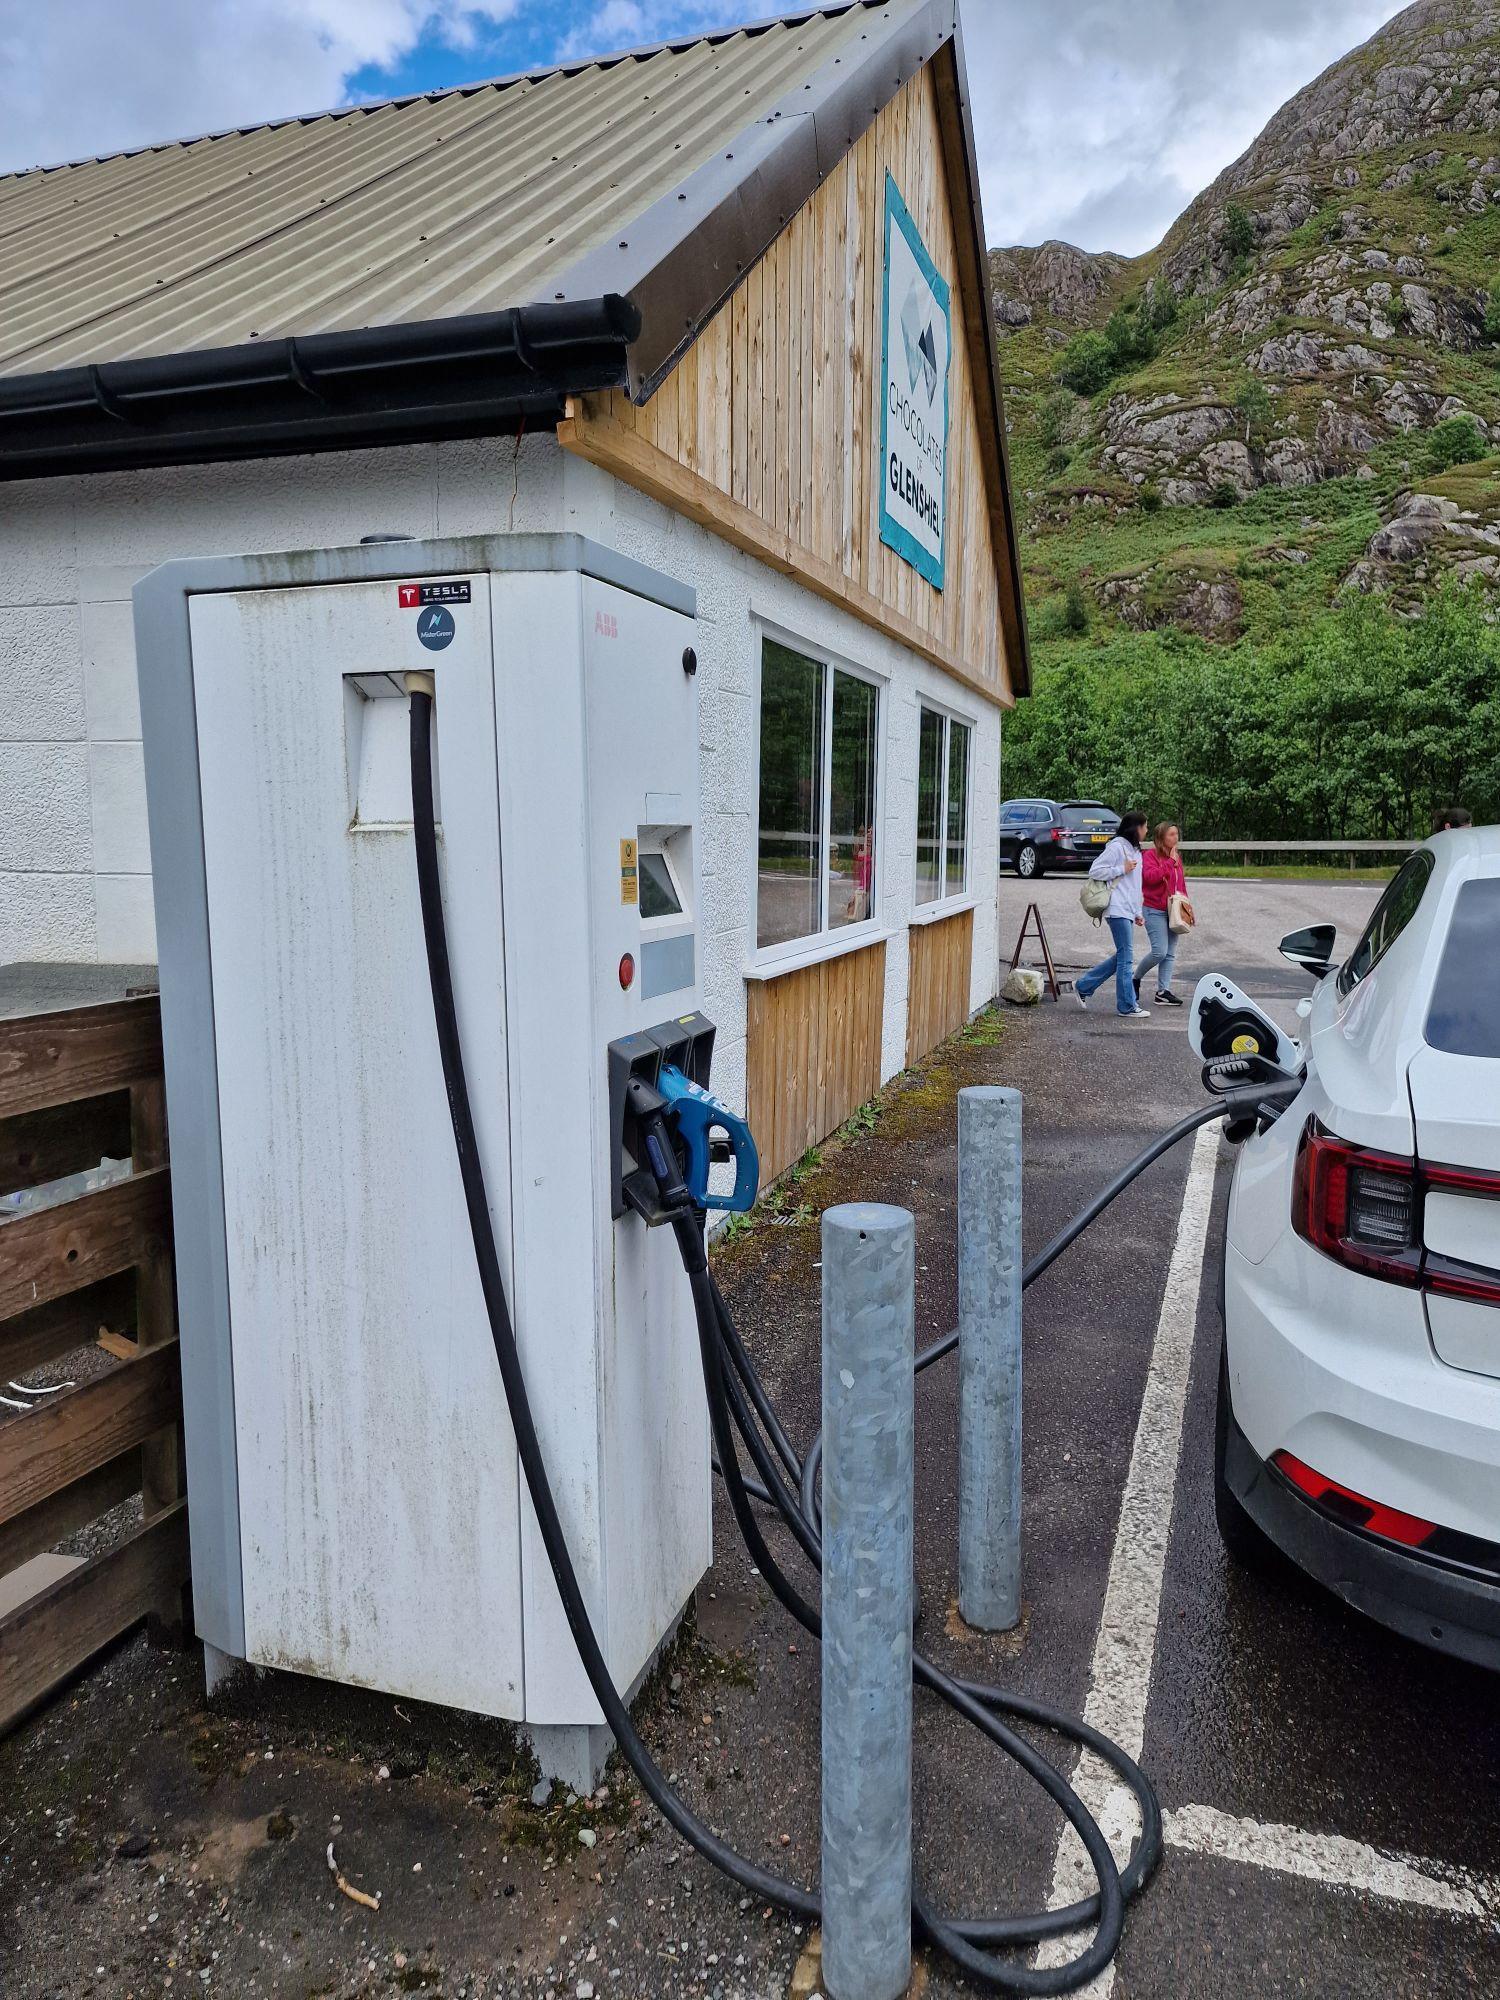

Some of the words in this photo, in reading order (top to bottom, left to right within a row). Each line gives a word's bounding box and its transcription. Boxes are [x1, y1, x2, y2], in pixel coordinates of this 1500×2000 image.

[889, 381, 942, 476] CHOCOLATES
[890, 452, 940, 538] GLENSHIEL
[422, 585, 468, 596] TESLA
